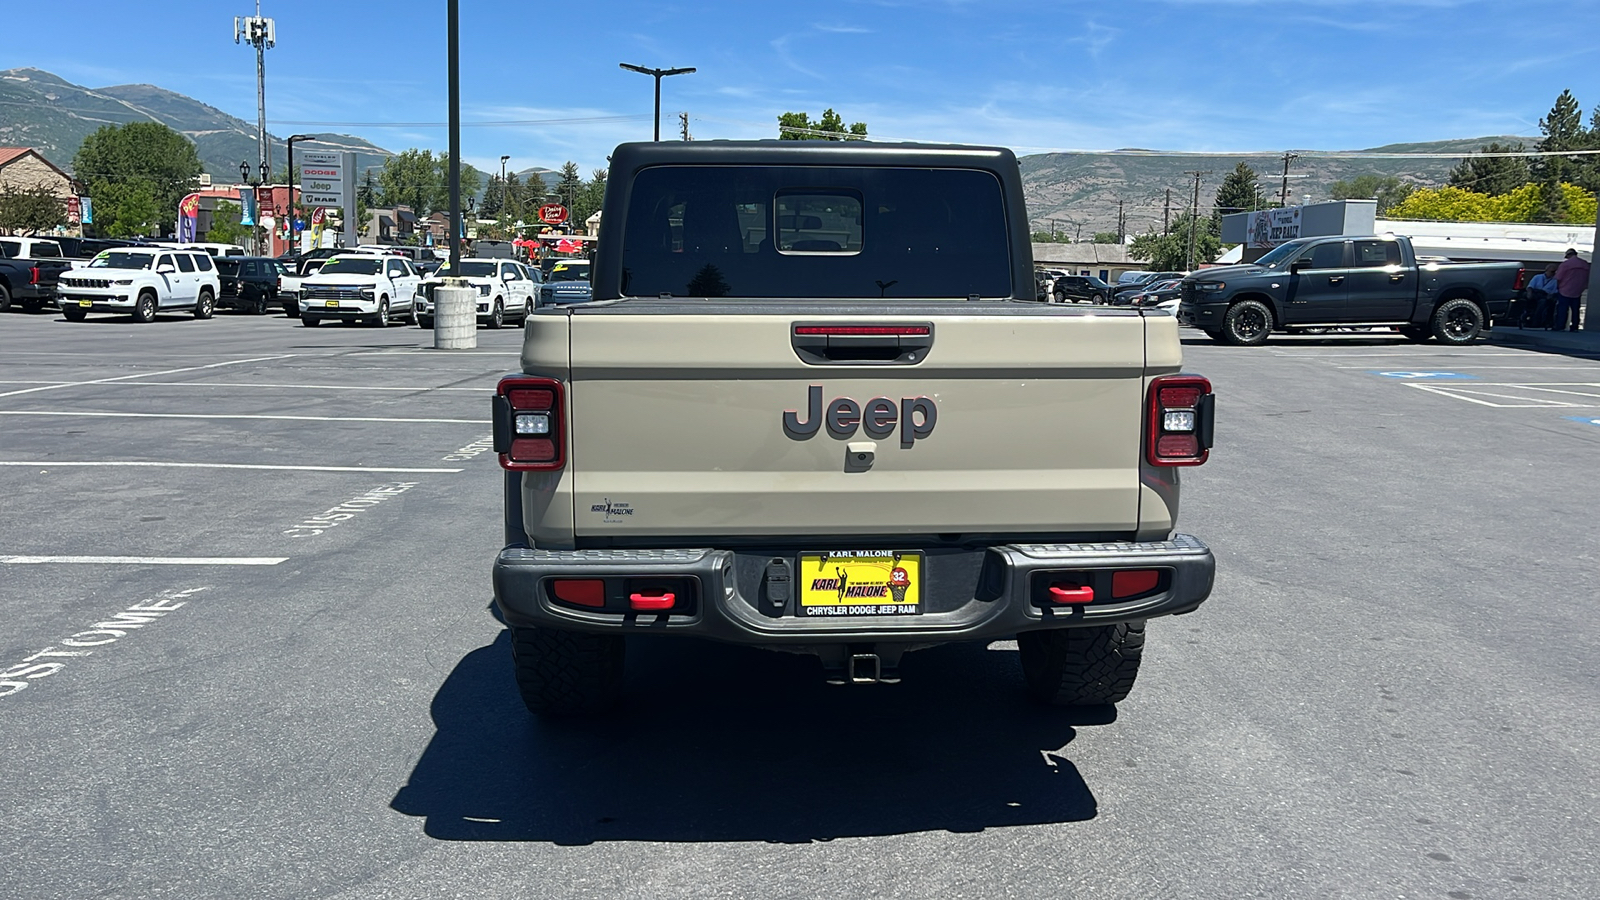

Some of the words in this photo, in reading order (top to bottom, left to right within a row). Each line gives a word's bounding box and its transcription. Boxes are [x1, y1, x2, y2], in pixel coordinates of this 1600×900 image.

[310, 181, 332, 191] Jeep
[783, 384, 938, 449] Jeep
[283, 481, 420, 538] CUSTOMER
[856, 550, 893, 558] MALONE
[893, 571, 905, 582] 32
[811, 578, 839, 591] KARL
[844, 585, 888, 598] MALONE
[806, 606, 847, 615] CHRYSLER
[849, 605, 876, 614] DODGE
[877, 605, 898, 614] JEEP
[899, 605, 915, 614] RAM
